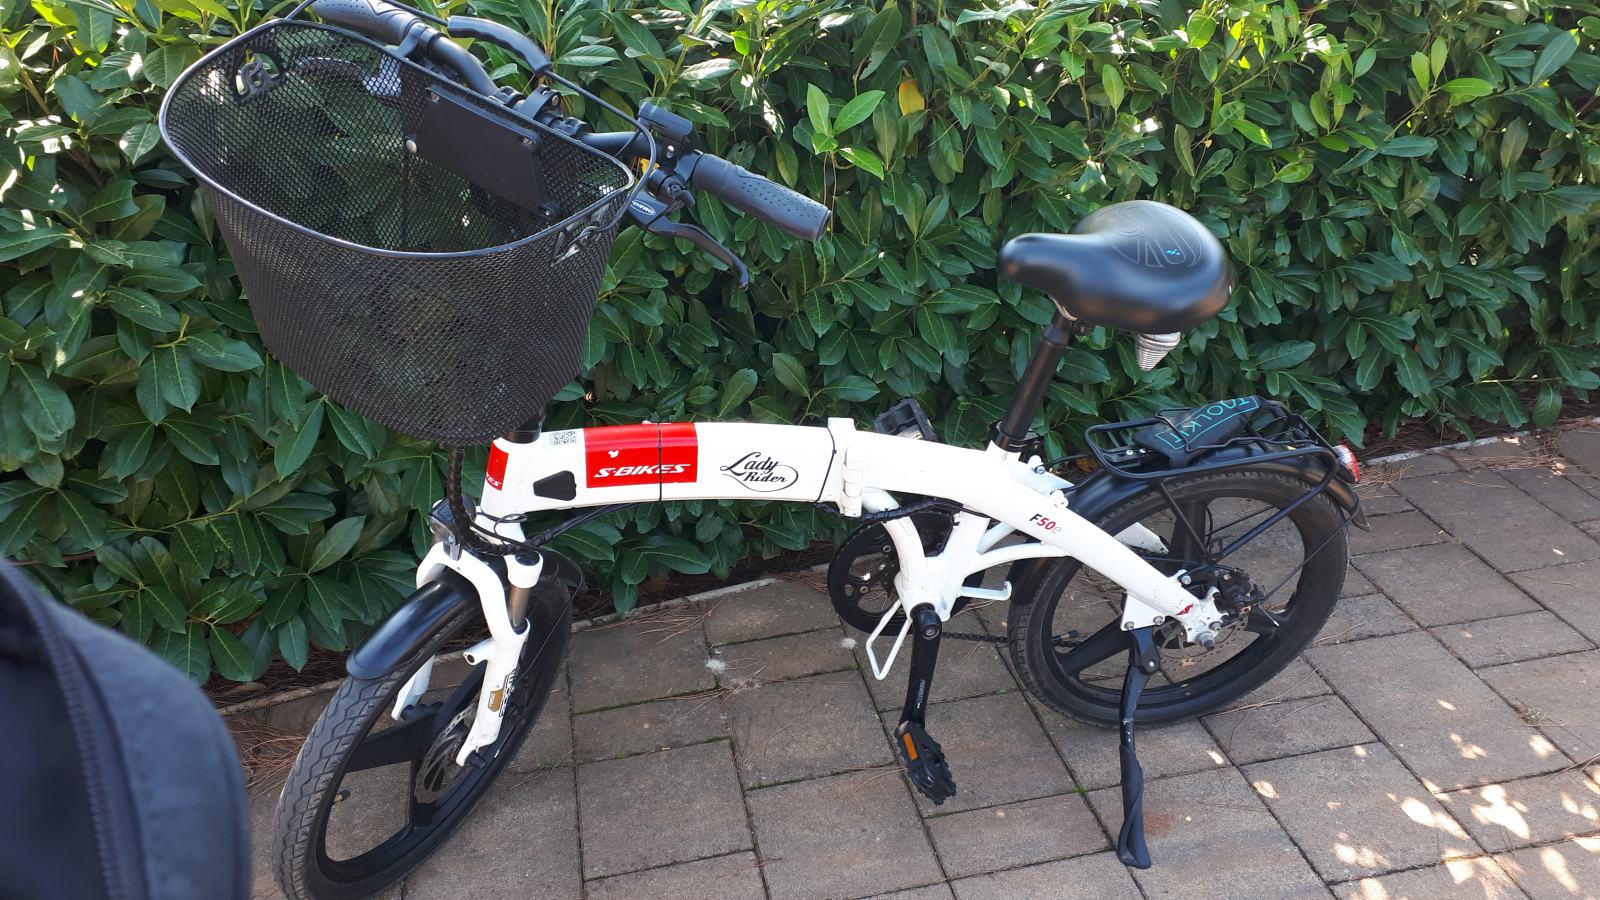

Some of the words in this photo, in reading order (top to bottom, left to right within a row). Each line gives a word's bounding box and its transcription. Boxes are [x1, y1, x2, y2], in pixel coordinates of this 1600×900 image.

[594, 463, 691, 478] S-BIKES
[719, 451, 778, 477] Lady
[743, 471, 787, 483] Rider
